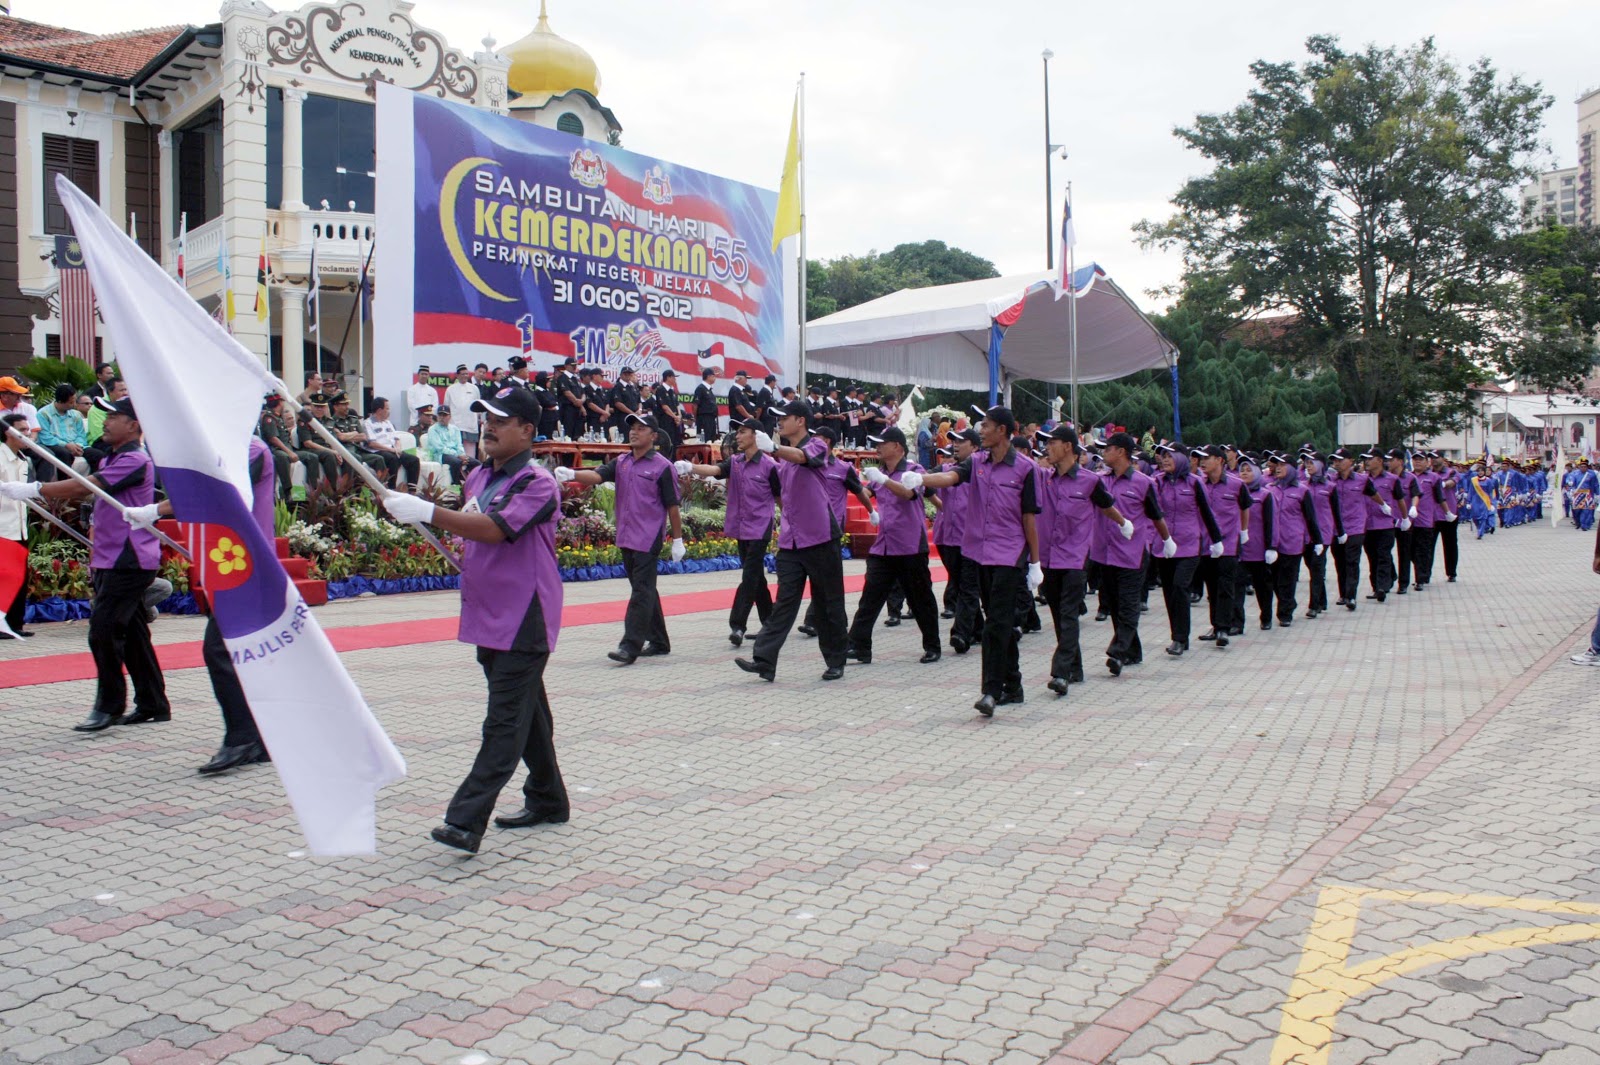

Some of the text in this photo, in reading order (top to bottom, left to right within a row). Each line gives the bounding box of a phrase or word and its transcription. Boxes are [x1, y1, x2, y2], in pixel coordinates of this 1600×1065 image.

[329, 27, 422, 68] MEMORIAL PENGISYTIHARAN
[350, 49, 403, 67] KEMERDEKAAN
[475, 170, 705, 239] SAMBUTAN HARI
[475, 198, 707, 277] KEMERDEKAAN
[473, 241, 711, 295] PERINGKAT NEGERI MELAKA
[553, 279, 692, 320] 31 OGOS 2012
